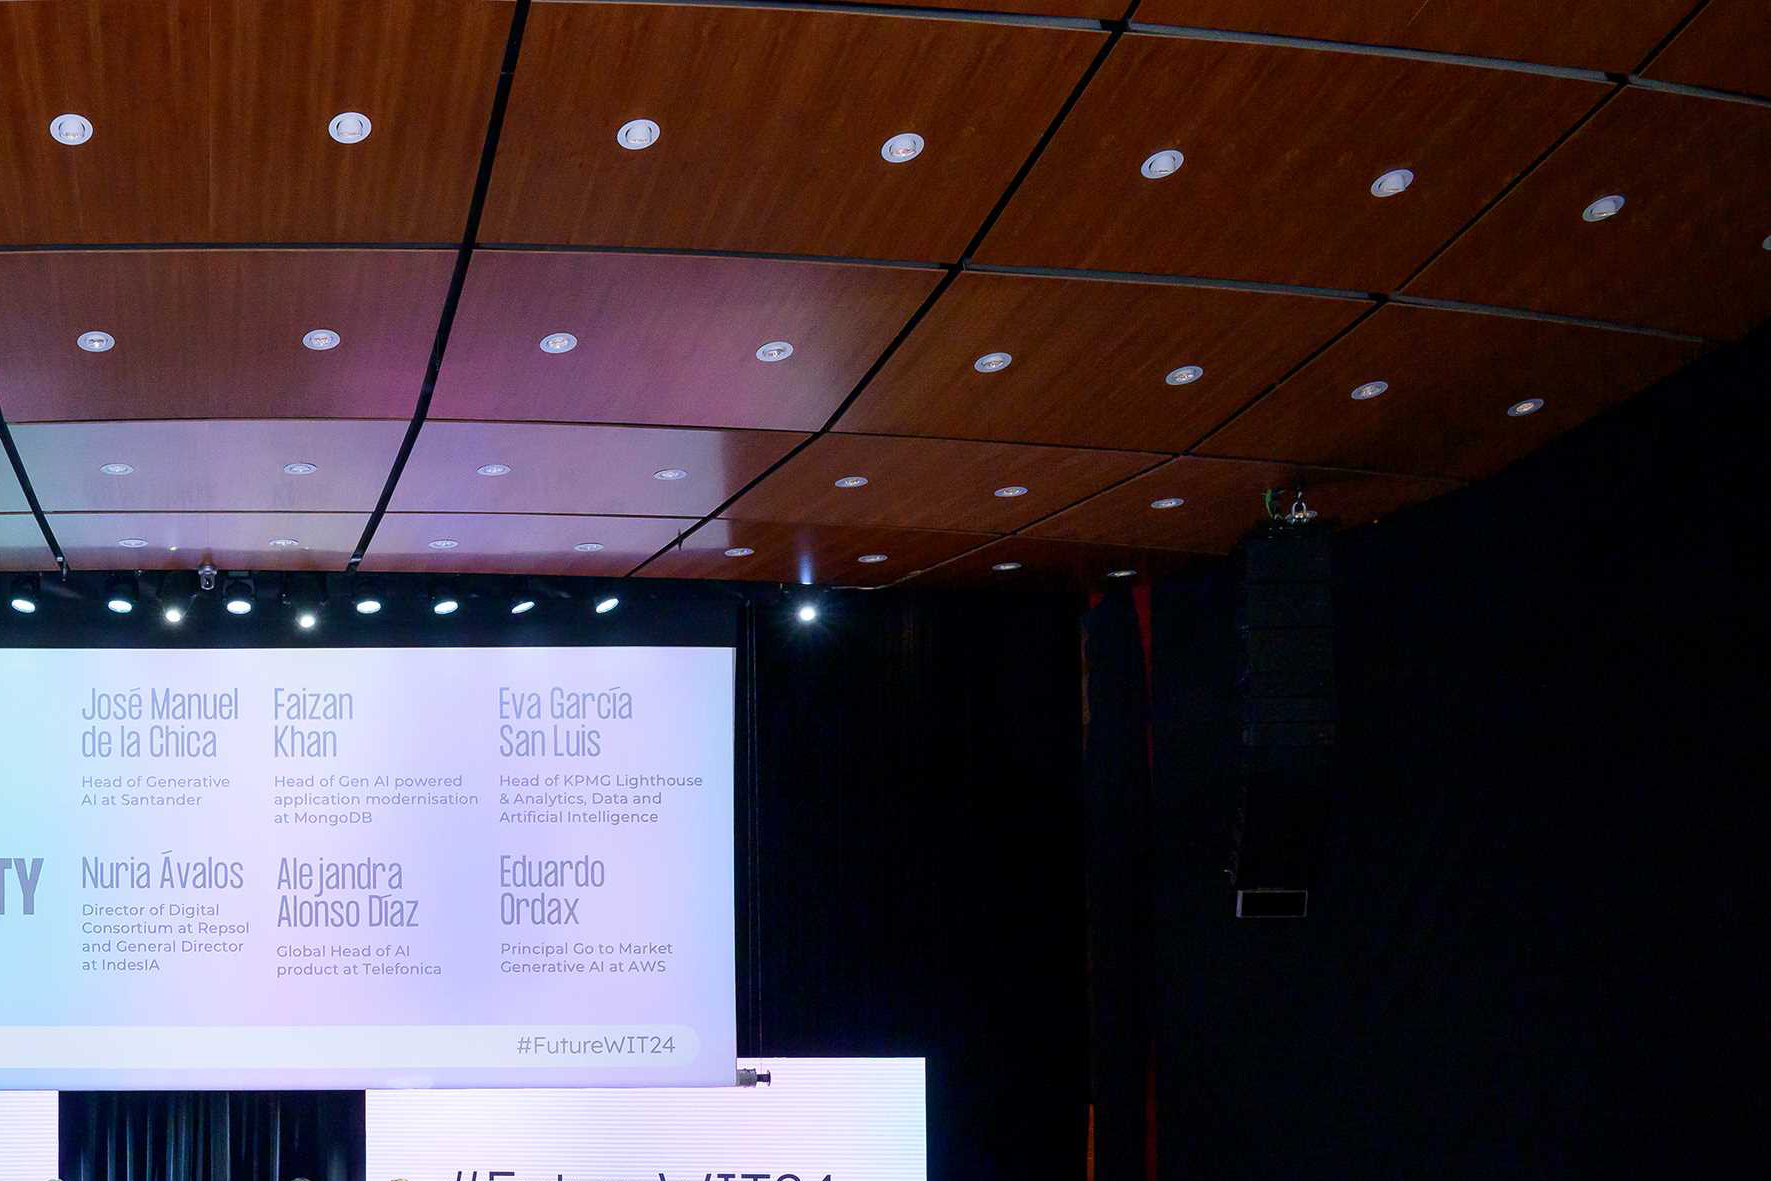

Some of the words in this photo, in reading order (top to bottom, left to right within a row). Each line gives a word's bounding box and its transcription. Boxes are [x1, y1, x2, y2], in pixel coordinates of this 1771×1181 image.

[81, 686, 143, 721] José
[150, 687, 239, 721] Manuel
[274, 687, 354, 721] Faizan
[499, 686, 542, 720] Eva
[550, 686, 633, 720] García
[81, 725, 112, 760] de
[120, 724, 141, 758] la
[149, 724, 217, 758] Chica
[274, 724, 337, 758] Khan
[499, 724, 546, 758] San
[553, 723, 601, 758] Luis
[81, 775, 121, 789] Head
[126, 775, 143, 788] of
[146, 775, 230, 788] Generative
[274, 775, 315, 788] Head
[319, 774, 336, 788] of
[338, 775, 370, 788] Gen
[373, 775, 389, 787] AI
[394, 775, 463, 789] powered
[499, 774, 540, 787] Head
[544, 774, 560, 787] of
[563, 774, 611, 787] KPMG
[616, 774, 703, 790] Lighthouse
[81, 793, 97, 806] AI
[101, 795, 117, 806] at
[120, 793, 203, 806] Santander
[273, 792, 361, 808] application
[366, 792, 479, 806] modernisation
[499, 792, 510, 805] &
[512, 791, 587, 808] Analytics,
[592, 792, 628, 805] Data
[632, 791, 662, 805] and
[273, 813, 290, 824] at
[294, 811, 373, 827] MongoDB
[499, 810, 563, 824] Artificial
[567, 810, 659, 826] Intelligence
[81, 856, 151, 889] Nuria
[159, 849, 244, 890] Ávalos
[276, 856, 404, 898] Alejandra
[499, 854, 605, 888] Eduardo
[82, 903, 146, 917] Director
[148, 903, 165, 916] of
[169, 903, 219, 919] Digital
[277, 893, 360, 928] Alonso
[368, 893, 420, 928] Díaz
[500, 891, 580, 926] Ordax
[81, 921, 173, 935] Consortium
[178, 923, 194, 934] at
[198, 921, 250, 937] Repsol
[82, 939, 111, 953] and
[115, 939, 176, 953] General
[181, 940, 244, 953] Director
[276, 944, 326, 958] Global
[330, 944, 372, 958] Head
[375, 944, 392, 957] of
[394, 945, 410, 957] AI
[500, 942, 568, 958] Principal
[573, 942, 594, 955] Go
[598, 943, 615, 955] to
[619, 942, 673, 955] Market
[82, 960, 98, 971] at
[276, 963, 339, 978] product
[343, 964, 359, 976] at
[362, 962, 442, 975] Telefonica
[500, 959, 585, 973] Generative
[588, 960, 604, 973] AI
[609, 962, 625, 973] at
[627, 960, 666, 973] AWS
[516, 1034, 676, 1055] #FutureWIT24
